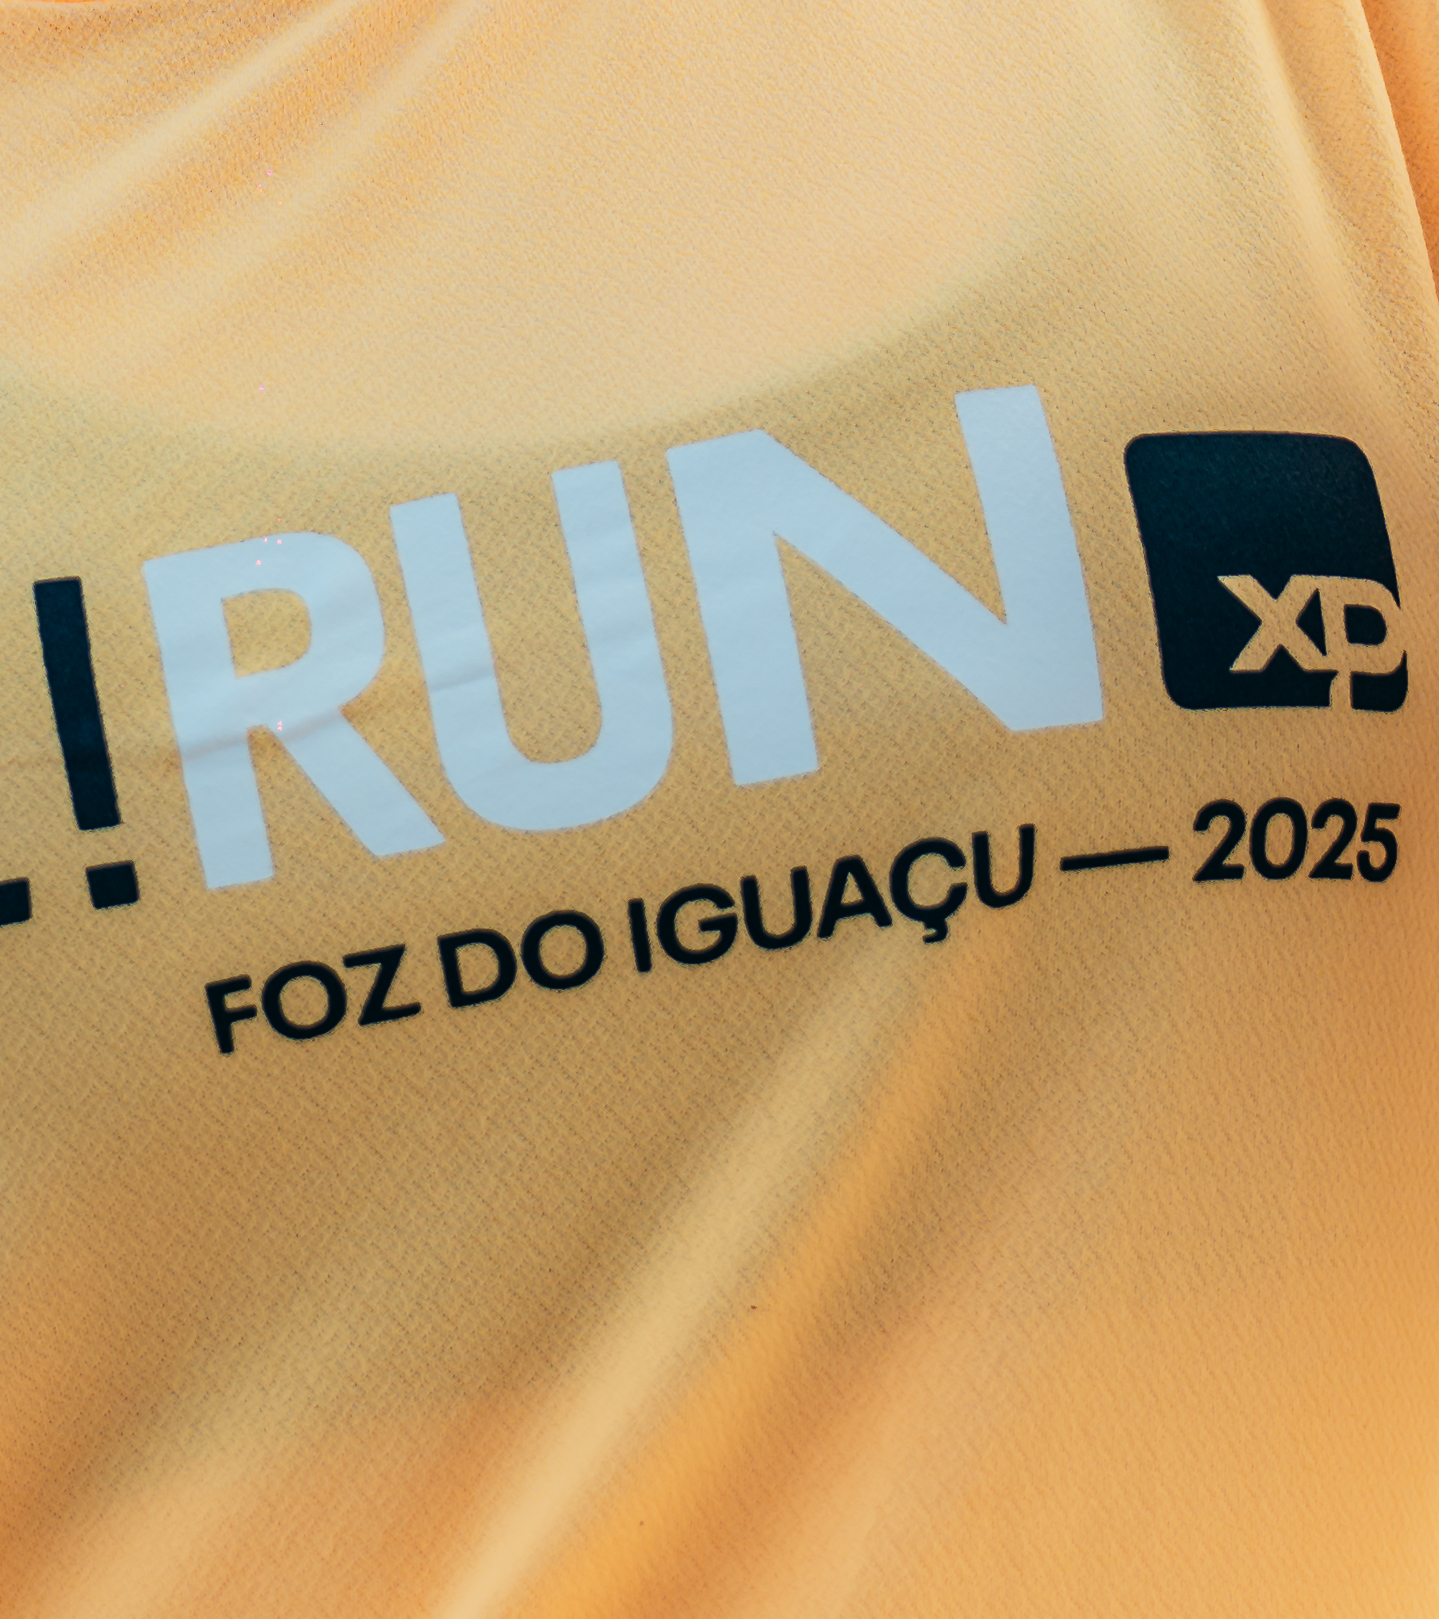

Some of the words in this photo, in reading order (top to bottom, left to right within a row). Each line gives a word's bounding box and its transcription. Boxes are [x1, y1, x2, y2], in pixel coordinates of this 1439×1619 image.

[205, 944, 422, 1054] FOZ
[438, 910, 606, 1008] DO
[628, 824, 1038, 973] IGUAÇU
[1192, 796, 1402, 883] 2025
